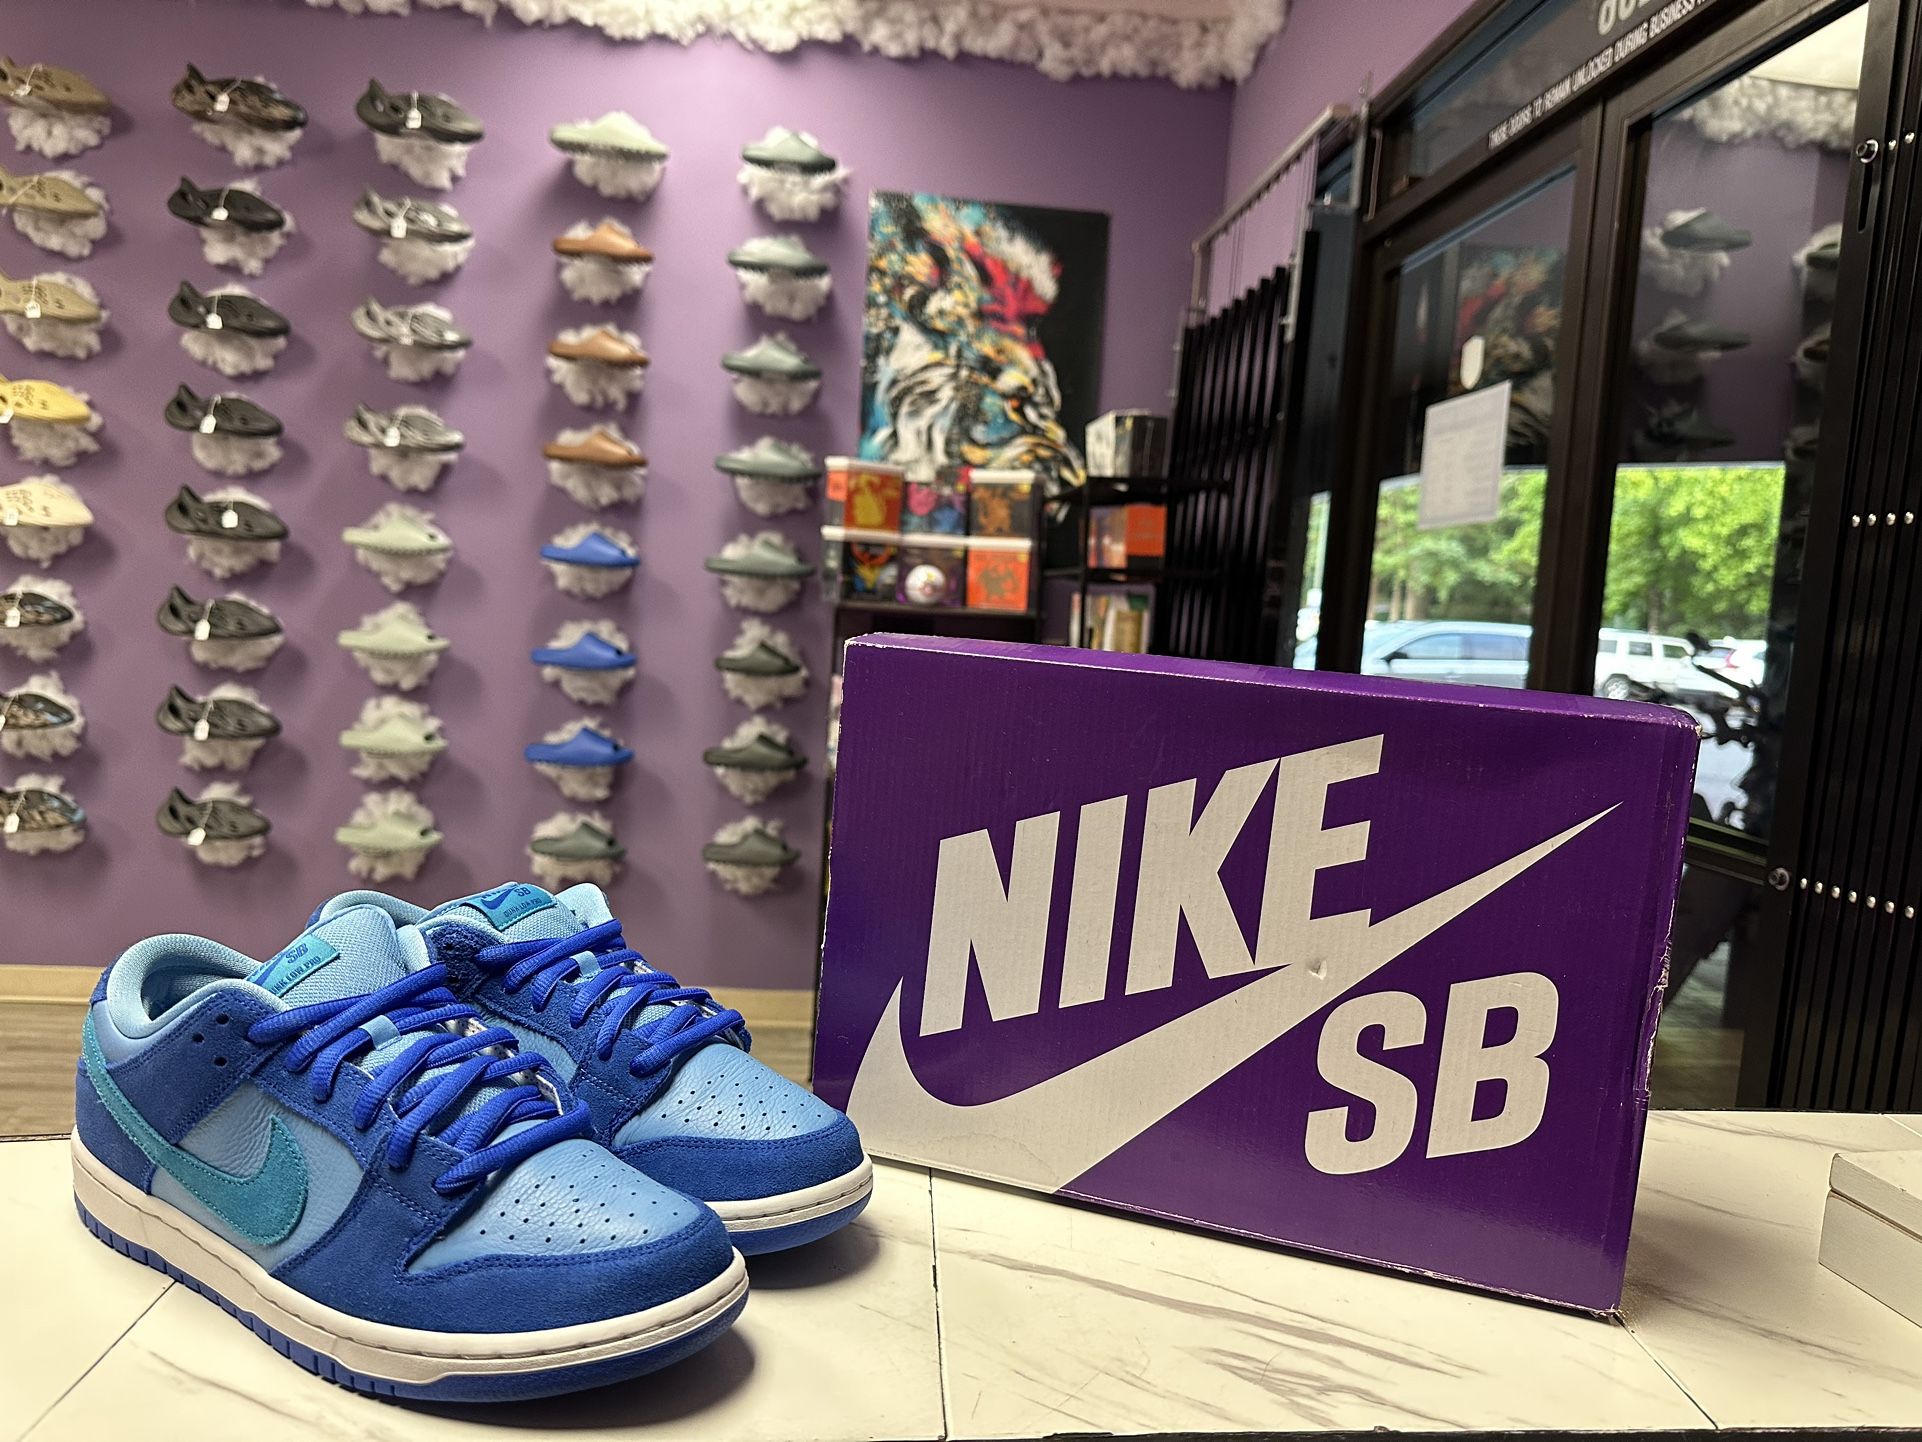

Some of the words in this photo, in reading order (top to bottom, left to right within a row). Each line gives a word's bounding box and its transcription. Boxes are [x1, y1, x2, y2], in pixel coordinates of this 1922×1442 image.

[1613, 21, 1649, 62] DURING
[514, 886, 532, 897] SB
[919, 733, 1385, 1037] NIKE
[285, 943, 309, 964] SB
[268, 977, 288, 995] UNK
[286, 964, 304, 982] LOW
[303, 955, 322, 969] PRO
[1304, 972, 1559, 1176] SB
